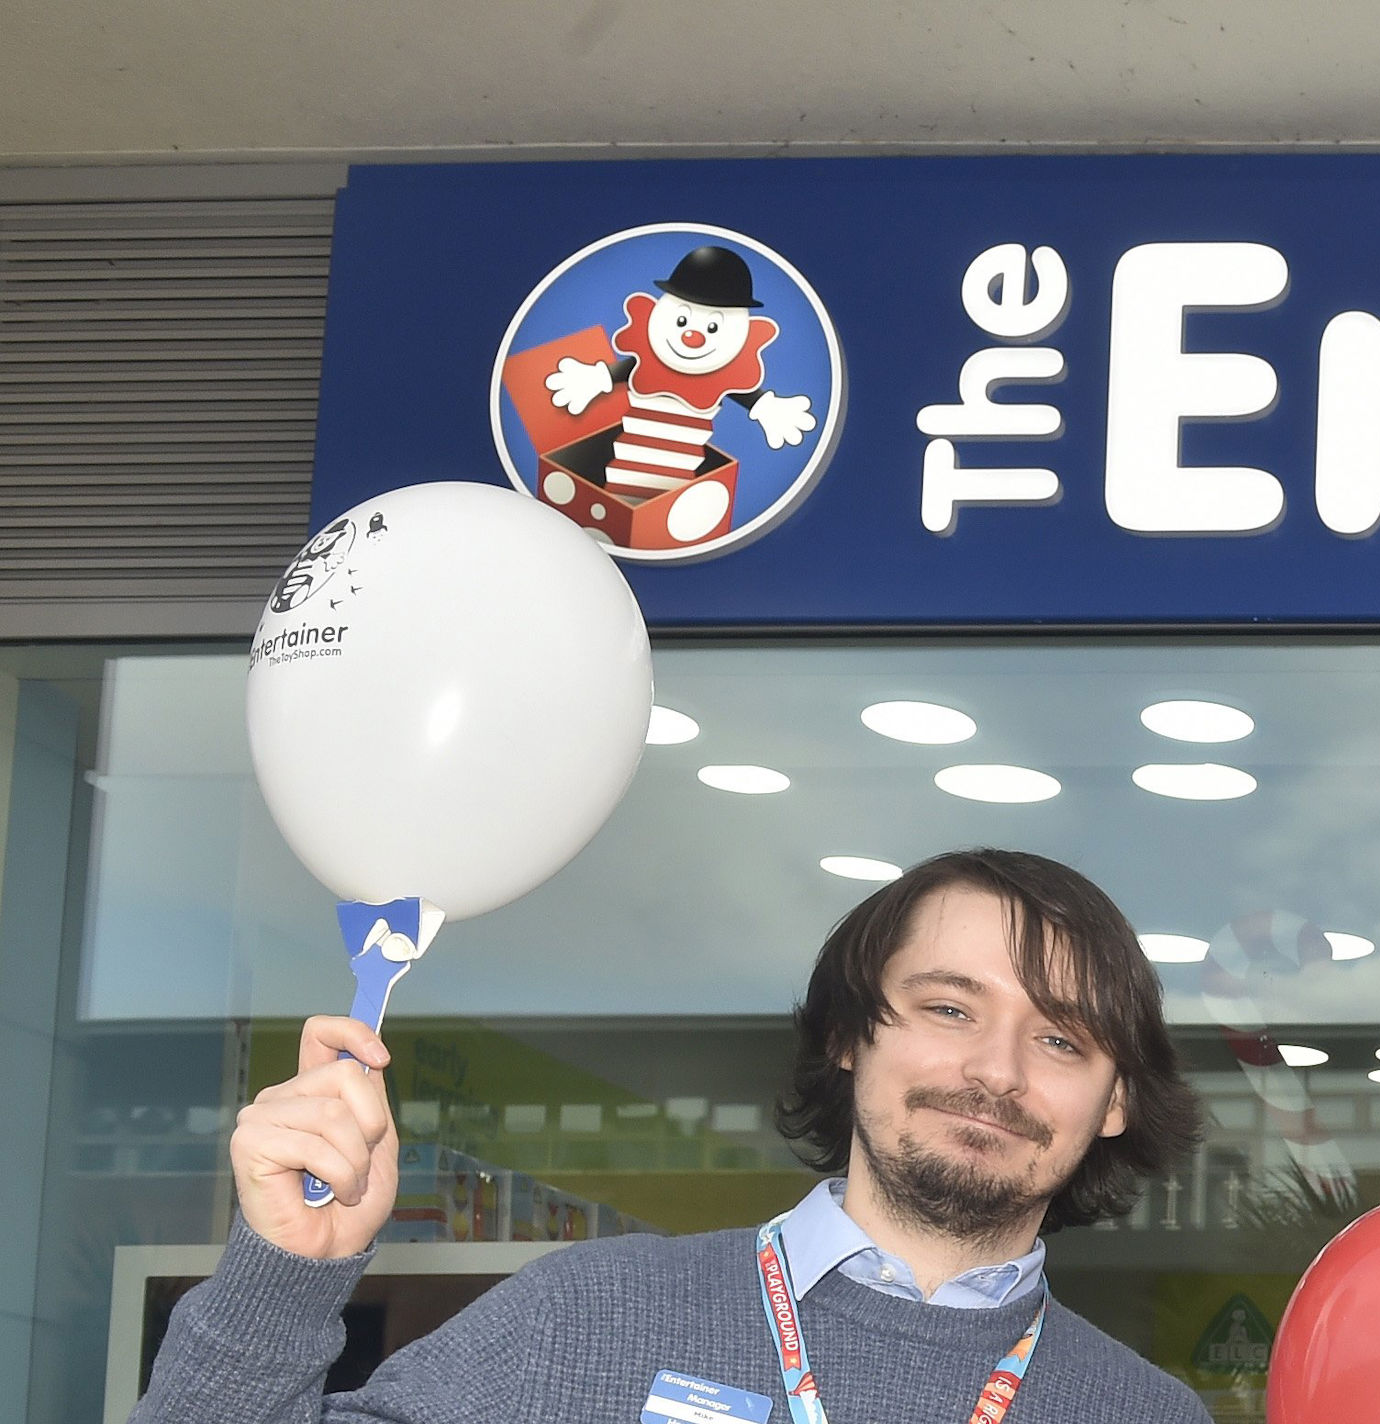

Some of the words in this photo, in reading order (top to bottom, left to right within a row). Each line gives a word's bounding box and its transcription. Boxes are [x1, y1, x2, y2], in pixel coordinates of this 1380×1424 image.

[916, 243, 1068, 532] The
[766, 1263, 799, 1352] PLAYGROUND
[994, 1375, 1013, 1393] IS
[686, 1393, 732, 1412] Manager
[988, 1391, 1003, 1405] A
